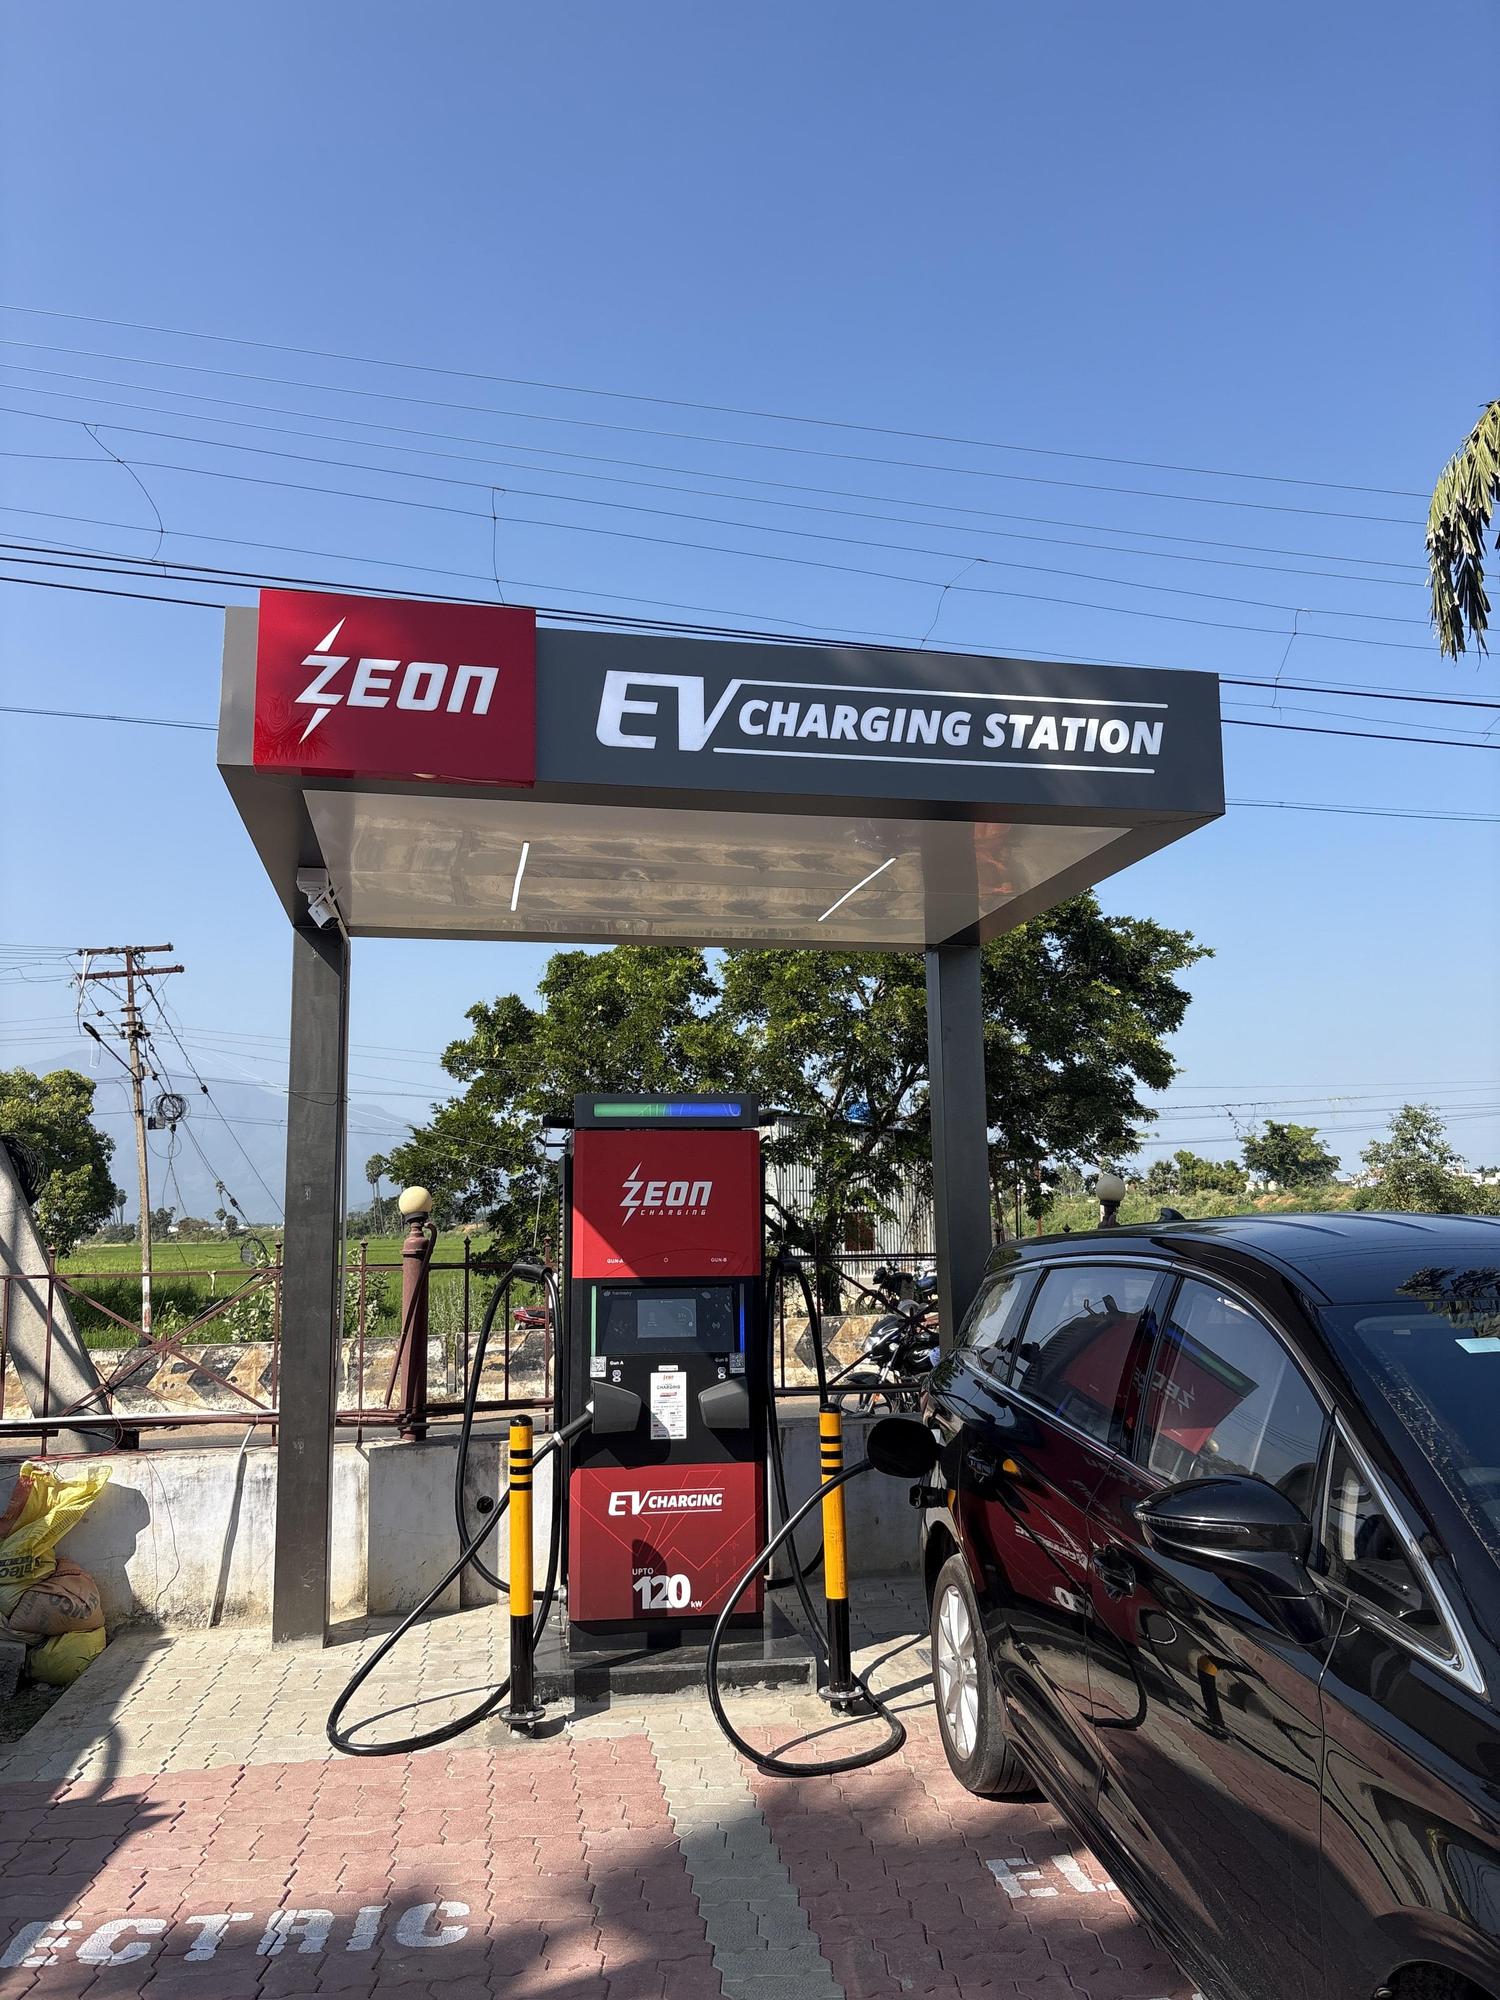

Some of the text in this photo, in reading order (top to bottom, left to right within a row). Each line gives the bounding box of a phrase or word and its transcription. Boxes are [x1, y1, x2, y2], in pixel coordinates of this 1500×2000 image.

[596, 670, 1165, 755] EV CHARGING STATION
[640, 1208, 708, 1216] CHARGING
[608, 1491, 723, 1516] EV CHARGING
[632, 1573, 703, 1610] 120 kW
